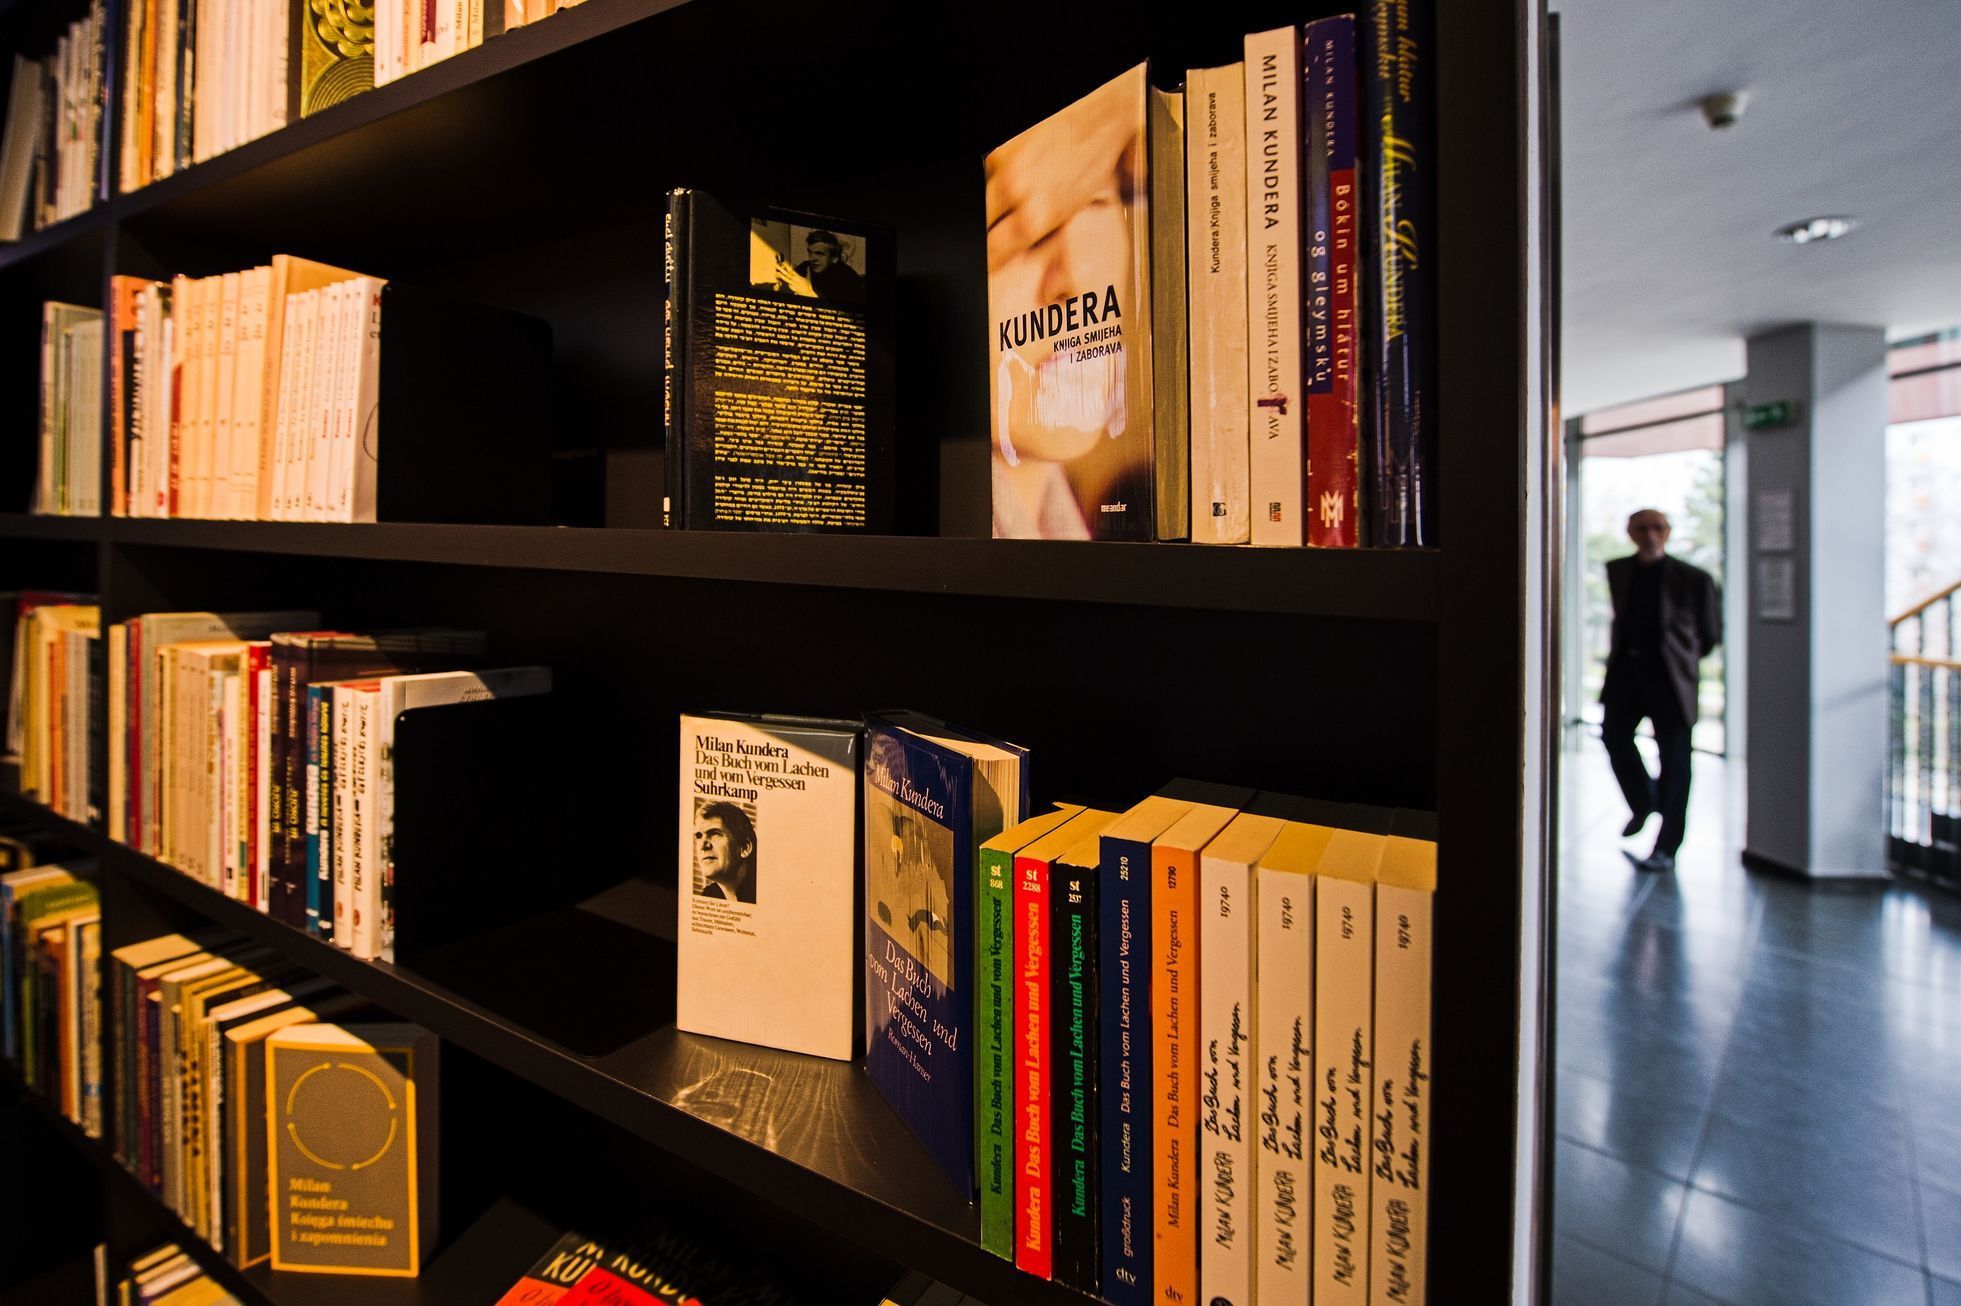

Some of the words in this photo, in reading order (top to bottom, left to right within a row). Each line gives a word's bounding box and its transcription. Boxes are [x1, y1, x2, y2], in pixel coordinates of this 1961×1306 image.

[1324, 39, 1335, 85] MILAN
[1262, 54, 1277, 121] MILAN
[1208, 92, 1218, 138] zaborava
[1324, 91, 1336, 158] KUNDERA
[1209, 151, 1220, 190] smijeha
[1263, 130, 1279, 230] KUNDERA
[1335, 184, 1351, 250] Bókin
[1311, 230, 1327, 258] og
[1266, 244, 1278, 290] KNJIGA
[1336, 264, 1349, 294] um
[999, 284, 1122, 352] KUNDERA
[1267, 293, 1279, 348] SMIJEHA
[1311, 271, 1329, 382] gleymsku
[1053, 335, 1082, 353] KNJIGA
[1084, 325, 1122, 344] SMIJEHA
[1070, 353, 1073, 364] I
[1076, 340, 1122, 363] ZABORAVA
[1336, 309, 1352, 381] hlátur
[1100, 501, 1127, 513] meandar
[695, 735, 734, 753] Milan
[736, 738, 789, 759] Kundera
[695, 751, 719, 766] Das
[721, 754, 752, 770] Buch
[753, 760, 779, 773] vom
[782, 759, 829, 778] Lachen
[695, 767, 717, 781] und
[719, 771, 744, 784] vom
[746, 772, 806, 791] Vergessen
[694, 779, 758, 803] Suhrkamp
[874, 764, 900, 798] Milan
[900, 778, 944, 820] Kundera
[989, 878, 1004, 890] 868
[991, 865, 1002, 877] st
[1026, 869, 1037, 881] st
[1120, 856, 1129, 881] 25210
[1022, 881, 1041, 893] 2288
[1069, 880, 1080, 892] st
[1220, 886, 1231, 918] 19740
[989, 896, 1004, 956] Vergessen
[1119, 900, 1132, 956] Vergessen
[1282, 897, 1293, 930] 19740
[1342, 906, 1354, 940] 19740
[1025, 902, 1042, 978] Vergessen
[1068, 914, 1085, 979] Vergessen
[1166, 910, 1181, 967] Vergessen
[1398, 915, 1411, 949] 19740
[886, 939, 904, 973] Das
[904, 964, 932, 999] Buch
[993, 958, 1002, 981] vom
[1120, 960, 1130, 984] und
[1166, 969, 1178, 993] und
[869, 952, 888, 984] vom
[891, 969, 928, 1023] Lachen
[932, 1018, 958, 1052] und
[991, 983, 1002, 1007] und
[1025, 981, 1040, 1011] und
[1069, 980, 1083, 1007] und
[1120, 987, 1130, 1029] Lachen
[886, 990, 932, 1056] Vergessen
[991, 1008, 1002, 1052] Lachen
[1070, 1008, 1083, 1058] Lachen
[1166, 998, 1179, 1040] Lachen
[1025, 1013, 1040, 1069] Lachen
[1121, 1034, 1130, 1057] vom
[1170, 1045, 1179, 1069] vom
[993, 1053, 1002, 1077] vom
[1074, 1059, 1083, 1087] vom
[1120, 1060, 1130, 1091] Buch
[1226, 1059, 1241, 1090] und
[991, 1078, 1002, 1111] Buch
[1028, 1070, 1040, 1101] vom
[1120, 1091, 1131, 1114] Das
[1166, 1072, 1179, 1105] Buch
[1203, 1067, 1220, 1109] Buch
[1286, 1075, 1303, 1107] und
[1071, 1087, 1084, 1123] Buch
[1167, 1106, 1179, 1129] Das
[1222, 1095, 1241, 1143] Lachen
[1262, 1084, 1279, 1127] Buch
[1319, 1097, 1338, 1139] Buch
[1345, 1086, 1362, 1120] und
[1402, 1100, 1420, 1135] und
[991, 1111, 1002, 1137] Das
[1025, 1103, 1040, 1144] Buch
[1071, 1123, 1085, 1152] Das
[1204, 1110, 1220, 1136] Das
[1281, 1111, 1302, 1160] Lachen
[1374, 1109, 1395, 1154] Buch
[1120, 1122, 1131, 1173] Kundera
[1262, 1128, 1279, 1154] Das
[1320, 1140, 1338, 1168] Das
[1339, 1124, 1362, 1175] Lachen
[990, 1144, 1002, 1195] Kundera
[1025, 1145, 1040, 1178] Das
[1167, 1139, 1180, 1191] Kundera
[1214, 1150, 1235, 1207] KUNDERA
[1375, 1154, 1394, 1184] Das
[1396, 1137, 1420, 1190] Lachen
[289, 1177, 331, 1193] Milan
[1072, 1159, 1085, 1217] Kundera
[1273, 1169, 1296, 1227] KUNDERA
[290, 1195, 348, 1211] Kundera
[1026, 1187, 1041, 1252] Kundera
[1167, 1191, 1180, 1229] Milan
[1331, 1184, 1355, 1242] KUNDERA
[1121, 1196, 1133, 1258] großdruck
[1385, 1199, 1411, 1259] KUNDERA
[1116, 1267, 1136, 1285] dtv
[1165, 1285, 1183, 1301] dtv
